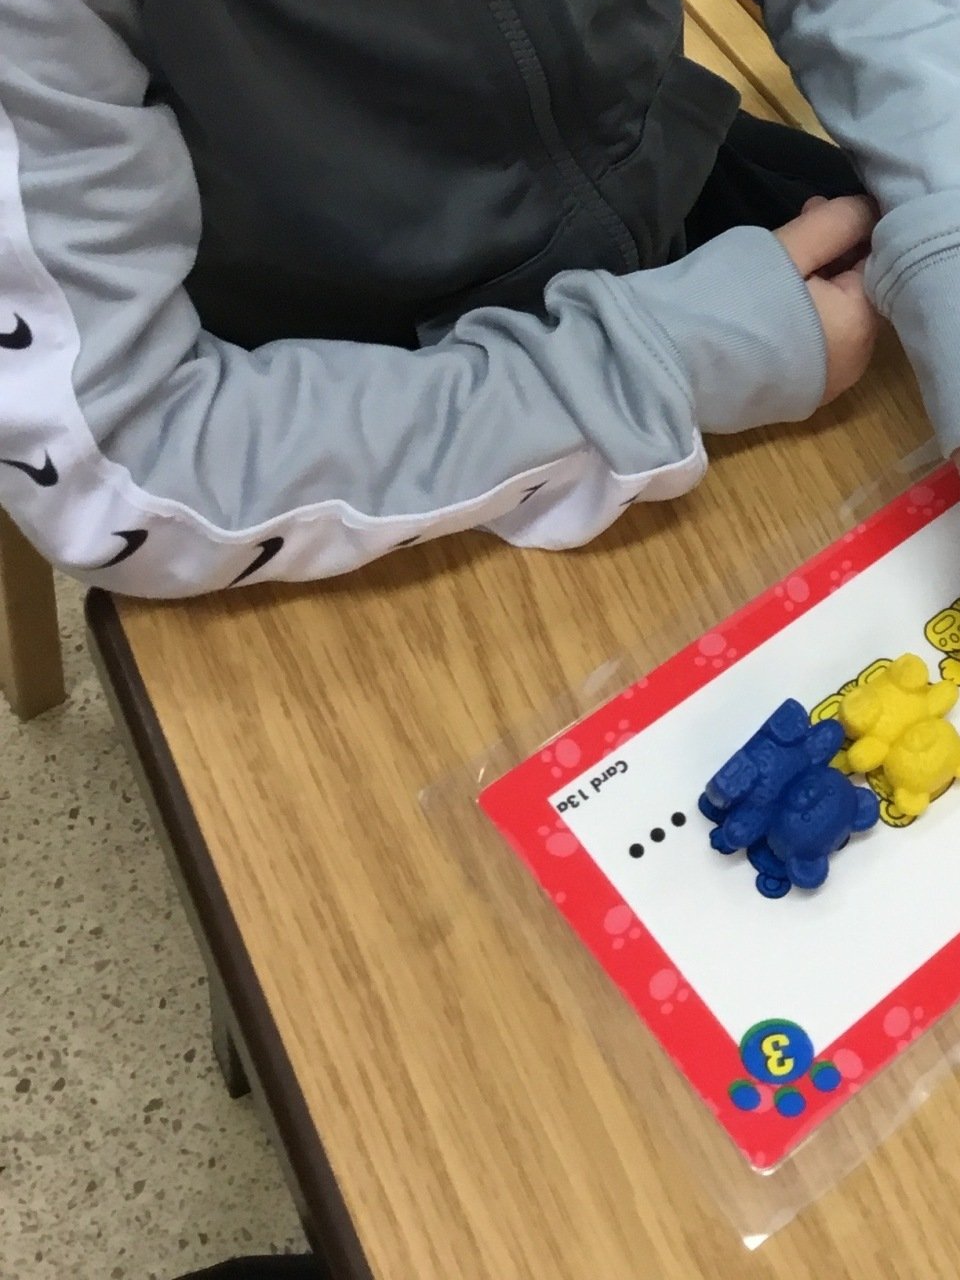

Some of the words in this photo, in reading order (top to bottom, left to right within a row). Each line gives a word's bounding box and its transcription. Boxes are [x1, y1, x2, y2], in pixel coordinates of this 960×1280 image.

[590, 760, 628, 793] Card
[556, 789, 589, 813] 13a
[761, 1033, 795, 1077] 3
